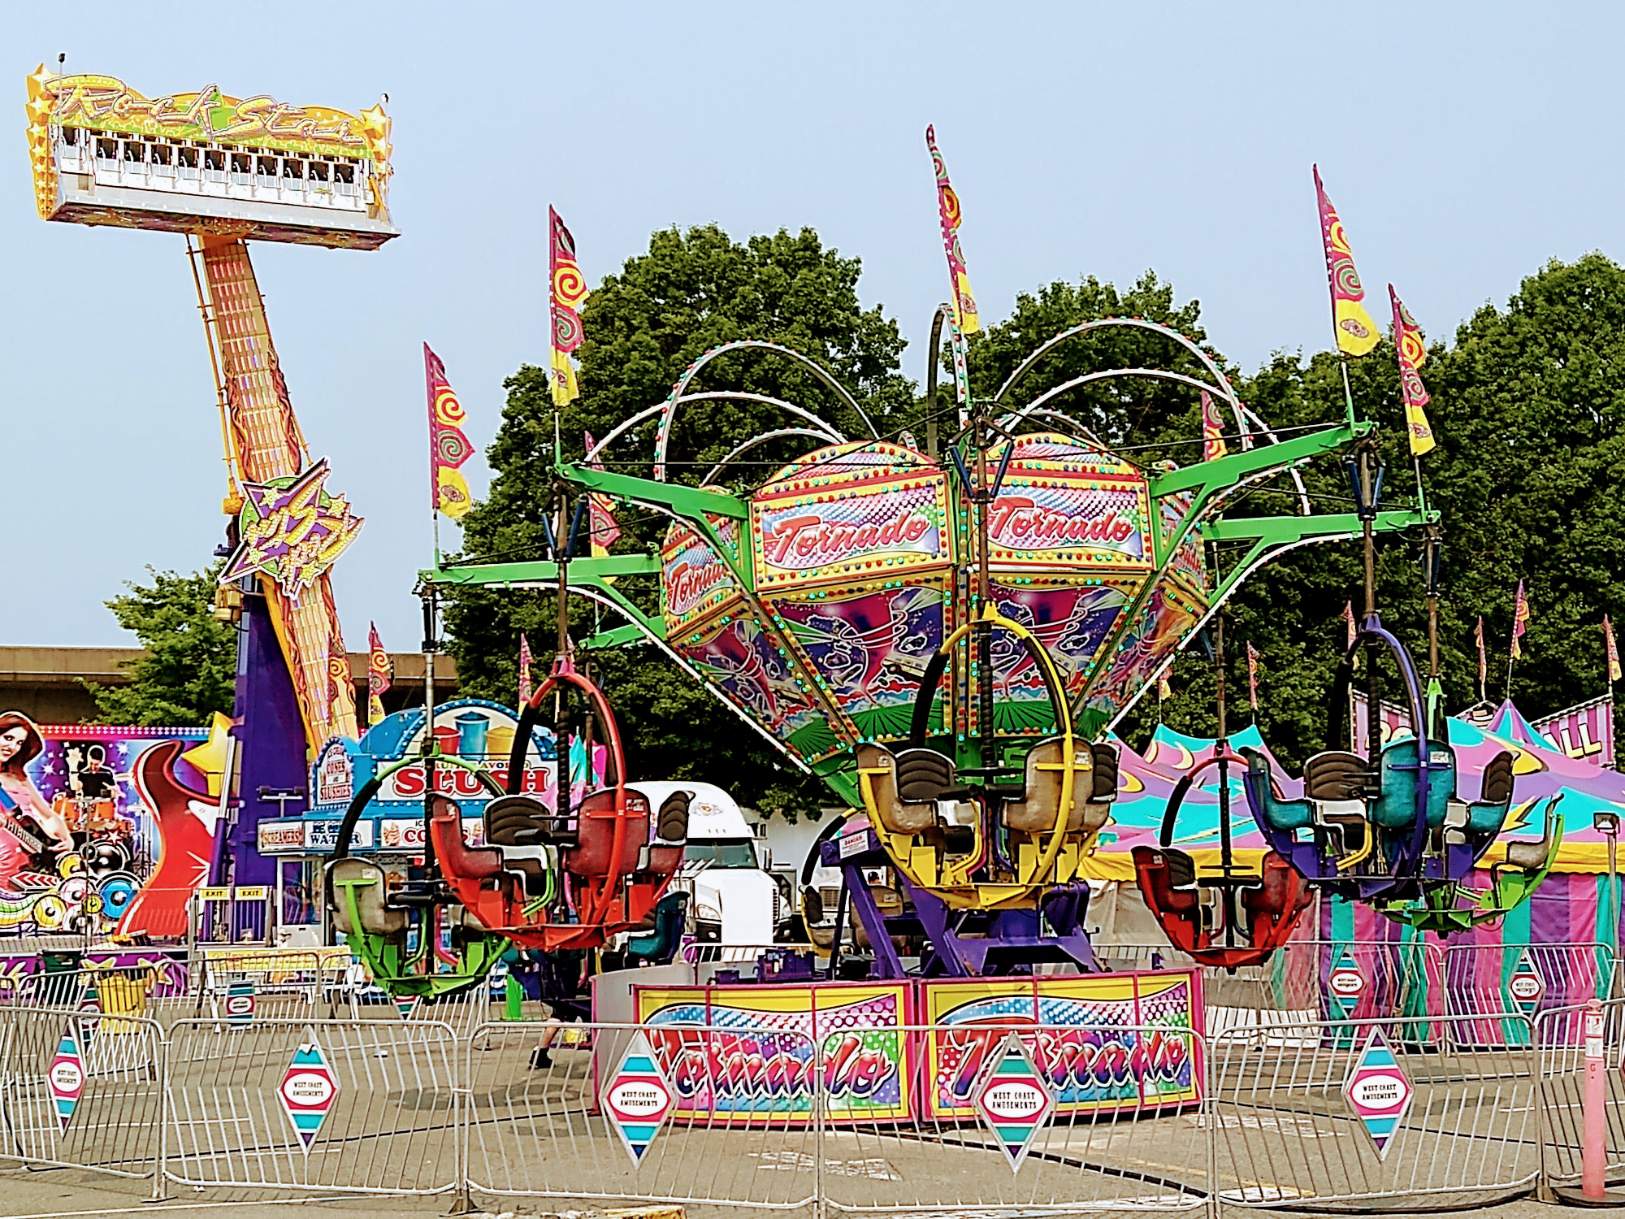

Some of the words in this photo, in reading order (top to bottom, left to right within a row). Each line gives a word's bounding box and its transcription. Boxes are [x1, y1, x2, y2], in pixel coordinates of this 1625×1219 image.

[44, 74, 220, 142] Rock
[211, 95, 366, 145] Star
[772, 510, 930, 565] Tornado
[989, 497, 1135, 543] Tornado
[670, 562, 724, 612] Torna
[395, 768, 550, 795] SLUSH
[310, 834, 360, 844] WATR
[403, 827, 469, 844] COS
[950, 1020, 1188, 1100] Trnado
[992, 1101, 1036, 1109] AMUSEMENTS
